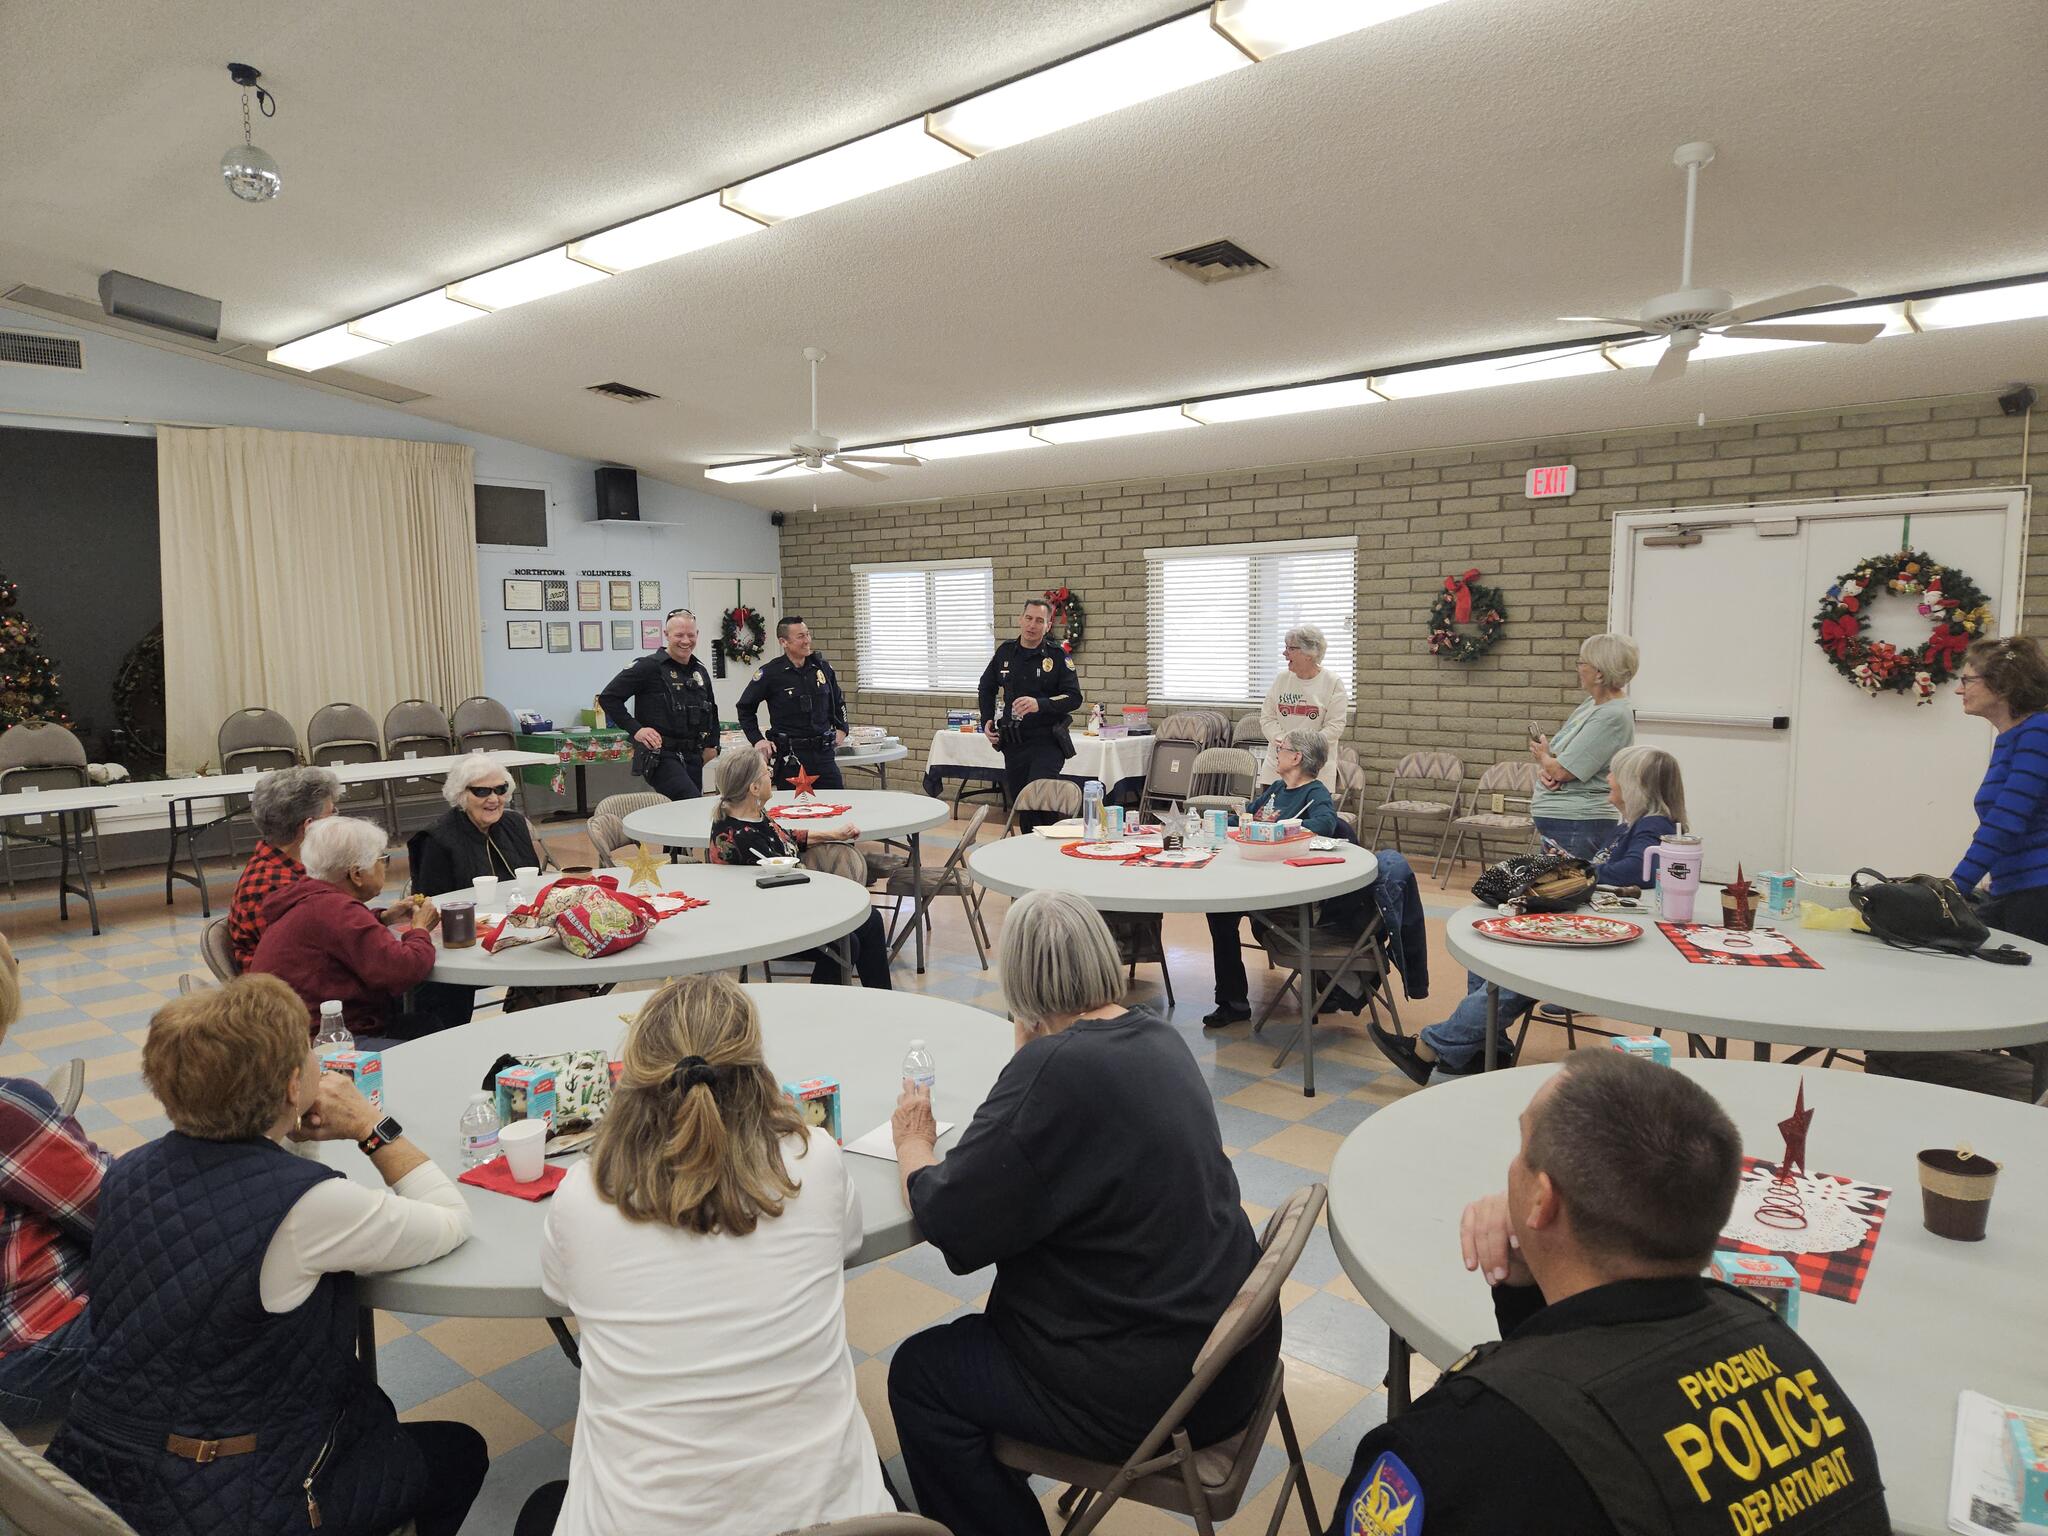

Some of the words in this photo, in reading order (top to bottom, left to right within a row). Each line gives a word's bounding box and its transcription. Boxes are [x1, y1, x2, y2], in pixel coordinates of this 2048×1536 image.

[1533, 466, 1569, 496] EXIT
[515, 568, 565, 576] NORTHTOWN
[1678, 1344, 1783, 1410] PHOENIX
[1663, 1368, 1847, 1504] POLICE
[1728, 1446, 1855, 1536] DEPARTMENT
